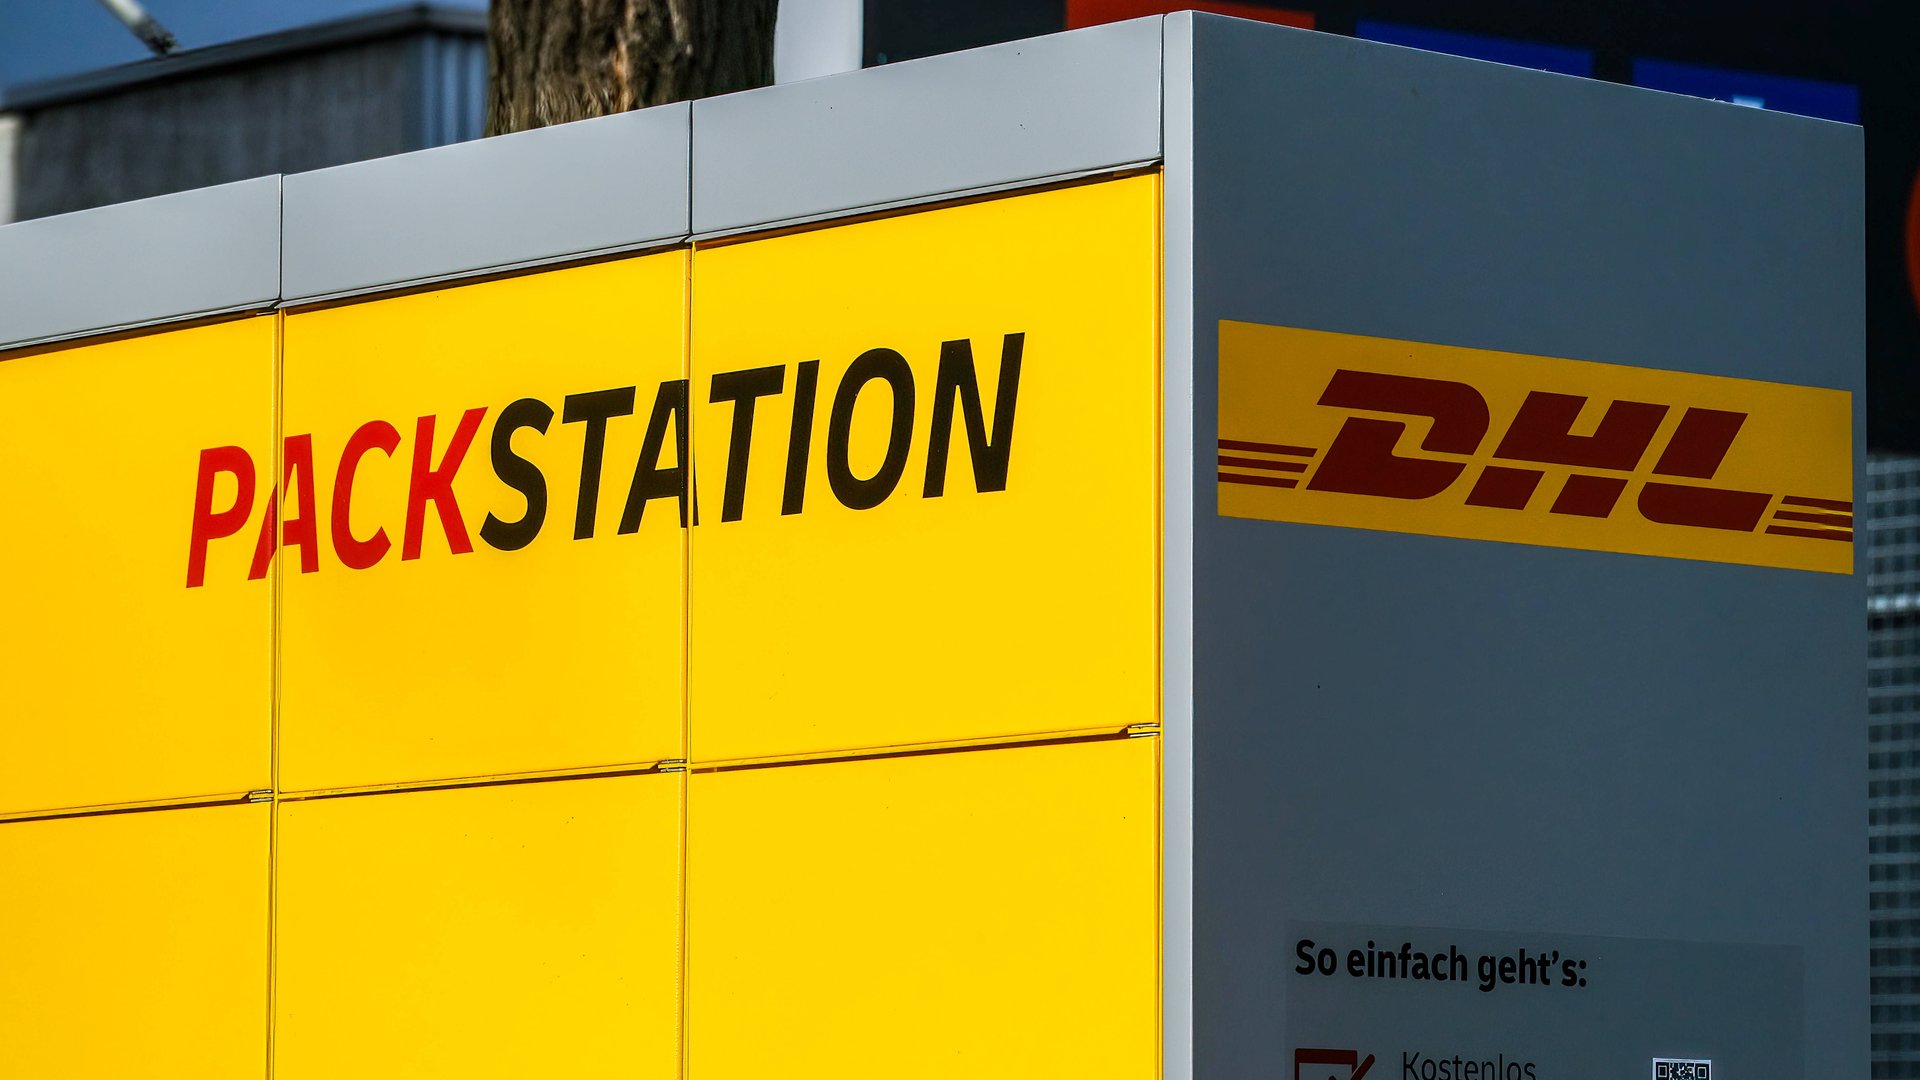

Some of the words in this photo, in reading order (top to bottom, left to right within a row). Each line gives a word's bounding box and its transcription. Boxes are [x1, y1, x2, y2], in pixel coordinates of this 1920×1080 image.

[186, 332, 1026, 588] PACKSTATION
[1306, 369, 1774, 533] DHL
[1295, 939, 1337, 976] So
[1347, 940, 1468, 981] einfach
[1402, 1051, 1536, 1080] Kostenlos
